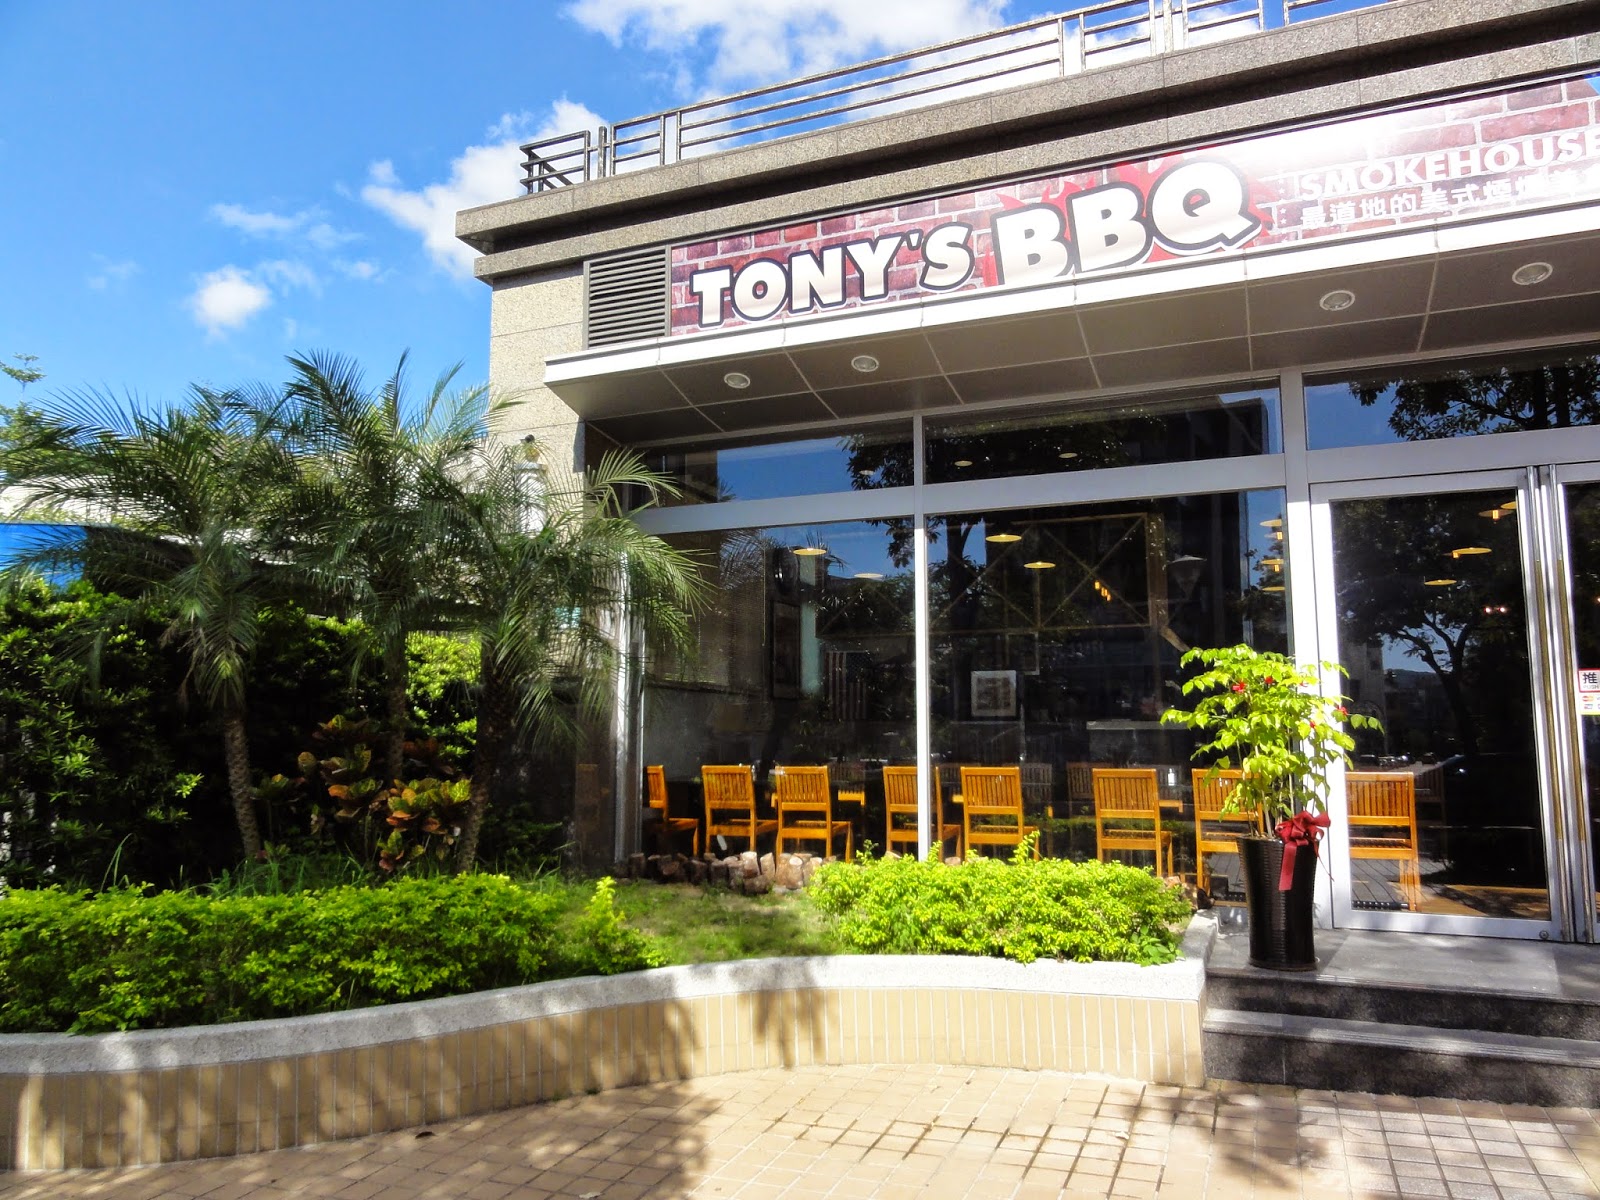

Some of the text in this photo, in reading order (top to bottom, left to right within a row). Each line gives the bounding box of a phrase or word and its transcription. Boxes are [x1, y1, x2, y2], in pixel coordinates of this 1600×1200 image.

[1301, 128, 1600, 201] SMOKEHOUSE
[690, 157, 1262, 328] TONY'S BBQ
[1582, 672, 1598, 684] 推
